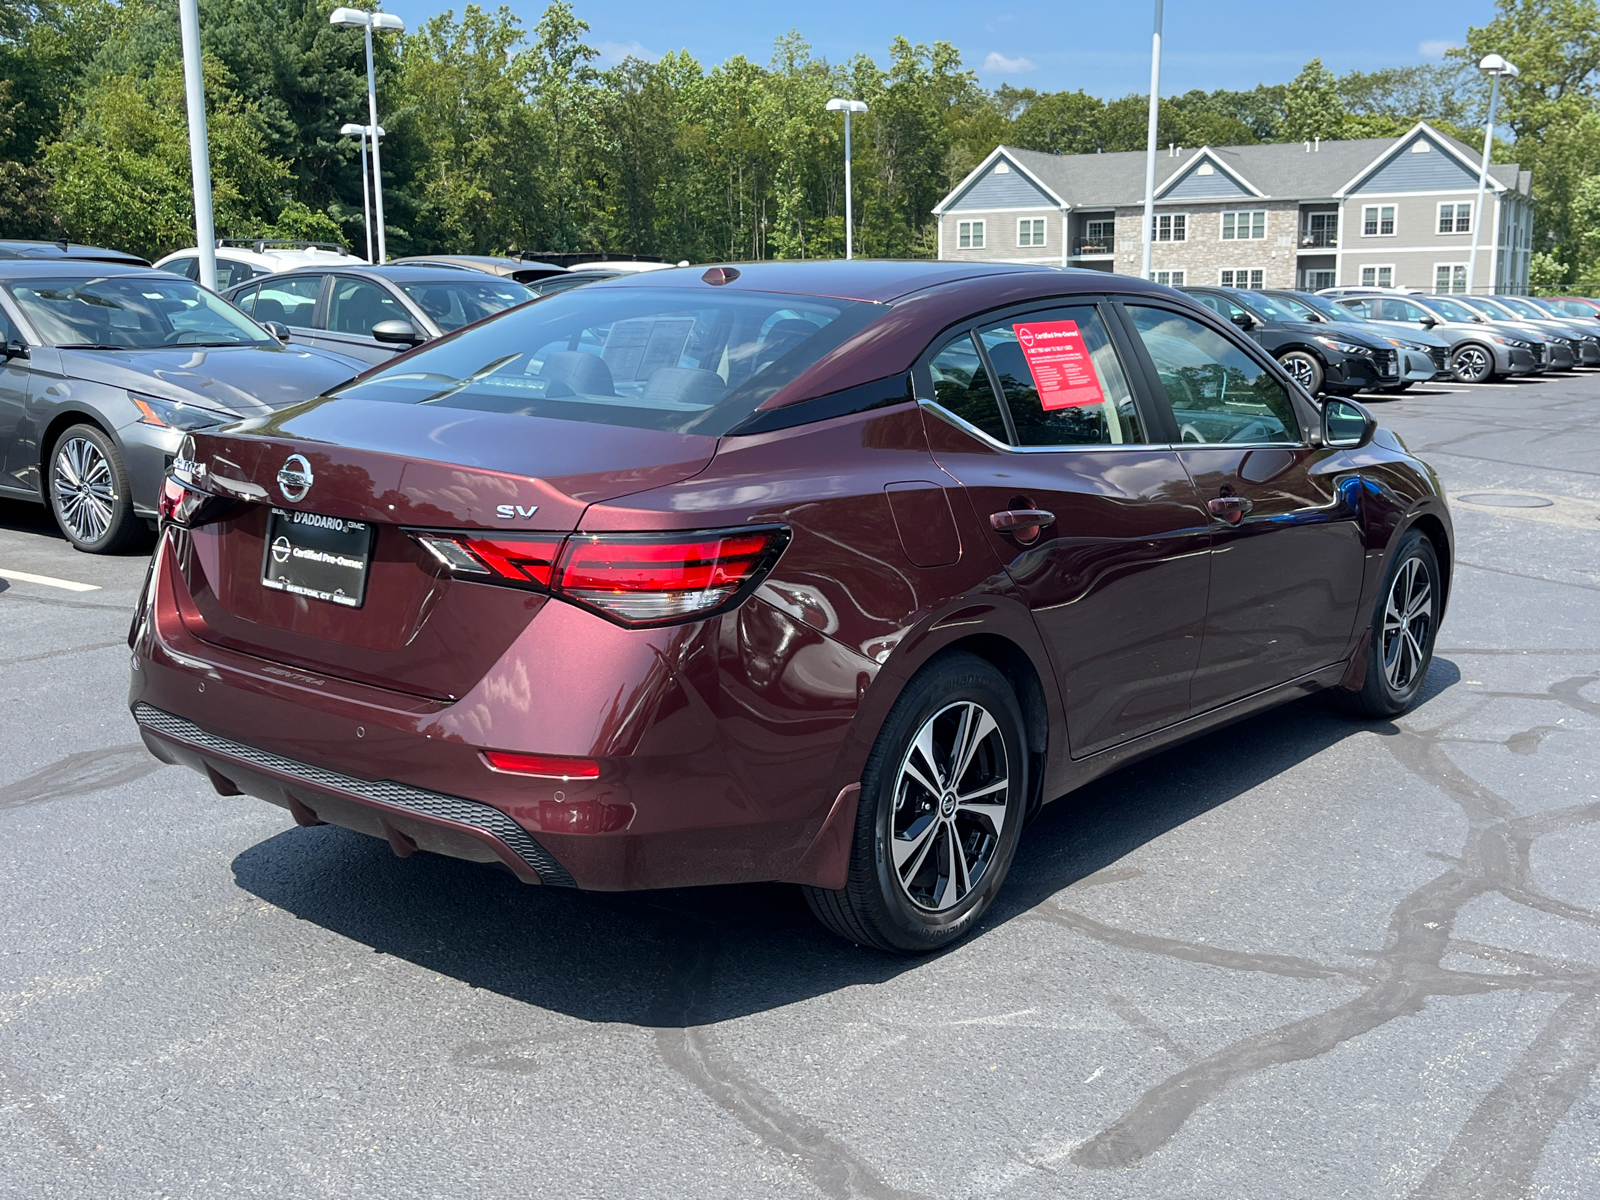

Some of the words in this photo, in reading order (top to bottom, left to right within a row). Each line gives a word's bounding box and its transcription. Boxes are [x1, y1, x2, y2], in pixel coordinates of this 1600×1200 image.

[1035, 332, 1054, 340] Certified
[1054, 330, 1079, 338] Pre-Owned
[496, 504, 539, 519] SV
[293, 511, 343, 531] D'ADDARIO
[347, 521, 365, 530] GMC
[293, 547, 322, 561] Certified
[320, 592, 331, 600] CT
[261, 667, 325, 686] SENTRA
